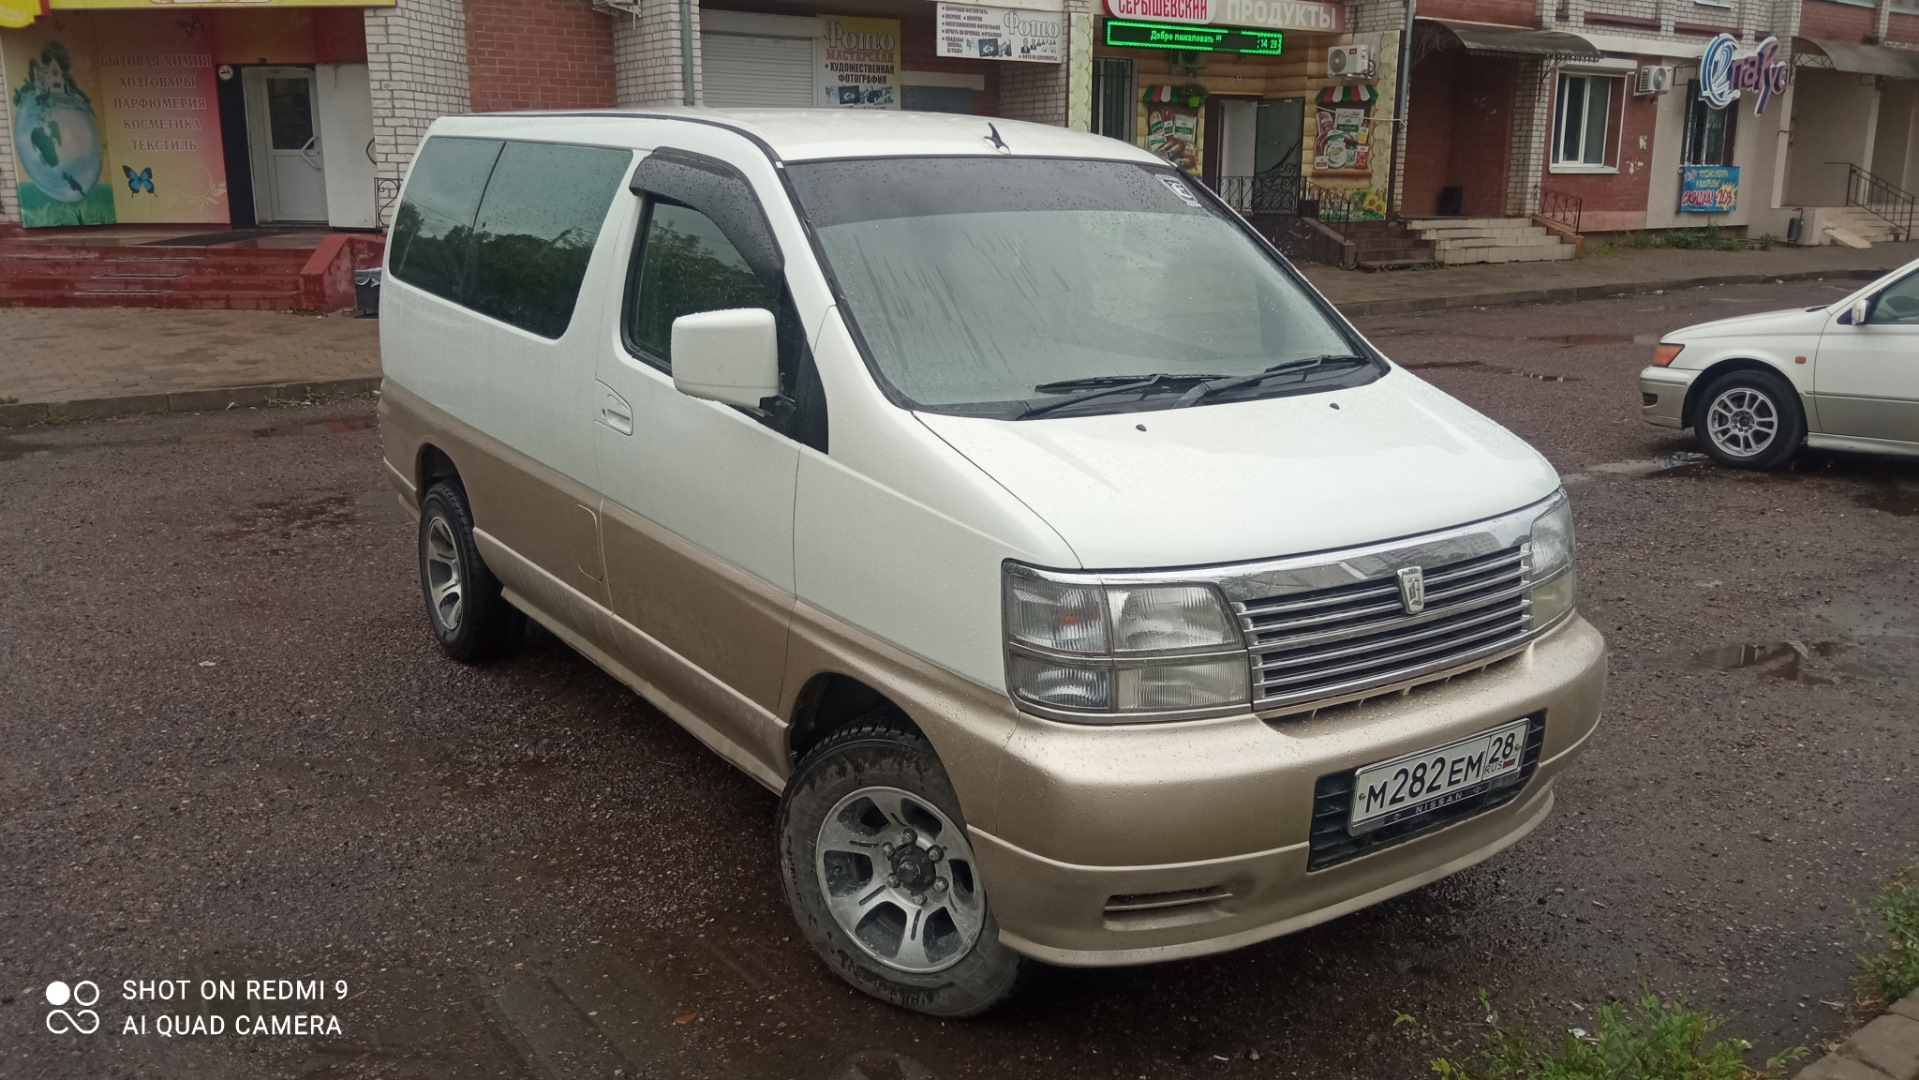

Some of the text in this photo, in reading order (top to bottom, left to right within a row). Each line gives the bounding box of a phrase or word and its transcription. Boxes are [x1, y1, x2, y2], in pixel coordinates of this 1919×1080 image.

[1226, 0, 1336, 29] ПРОДУКТЫ
[1003, 10, 1060, 39] Фото
[823, 18, 896, 52] Фото
[1150, 30, 1173, 42] Добро
[1174, 33, 1214, 43] пожаловать
[100, 55, 212, 68] БЫТОВАЯ ХИМИЯ
[826, 49, 895, 63] МАСТЕРСКАЯ
[830, 62, 895, 74] ХУДОЖЕСТВЕННАЯ
[119, 77, 196, 88] ХОЗТОВАРЫ
[838, 73, 887, 84] ФОТОГРАФИЯ
[113, 97, 207, 110] ПАРФЮМЕРИЯ
[123, 119, 202, 130] КОСМЕТИКА
[131, 140, 198, 151] ТЕКСТИЛЬ
[1488, 732, 1515, 764] 28
[1484, 760, 1504, 774] RUS
[1415, 792, 1463, 814] NISSAN
